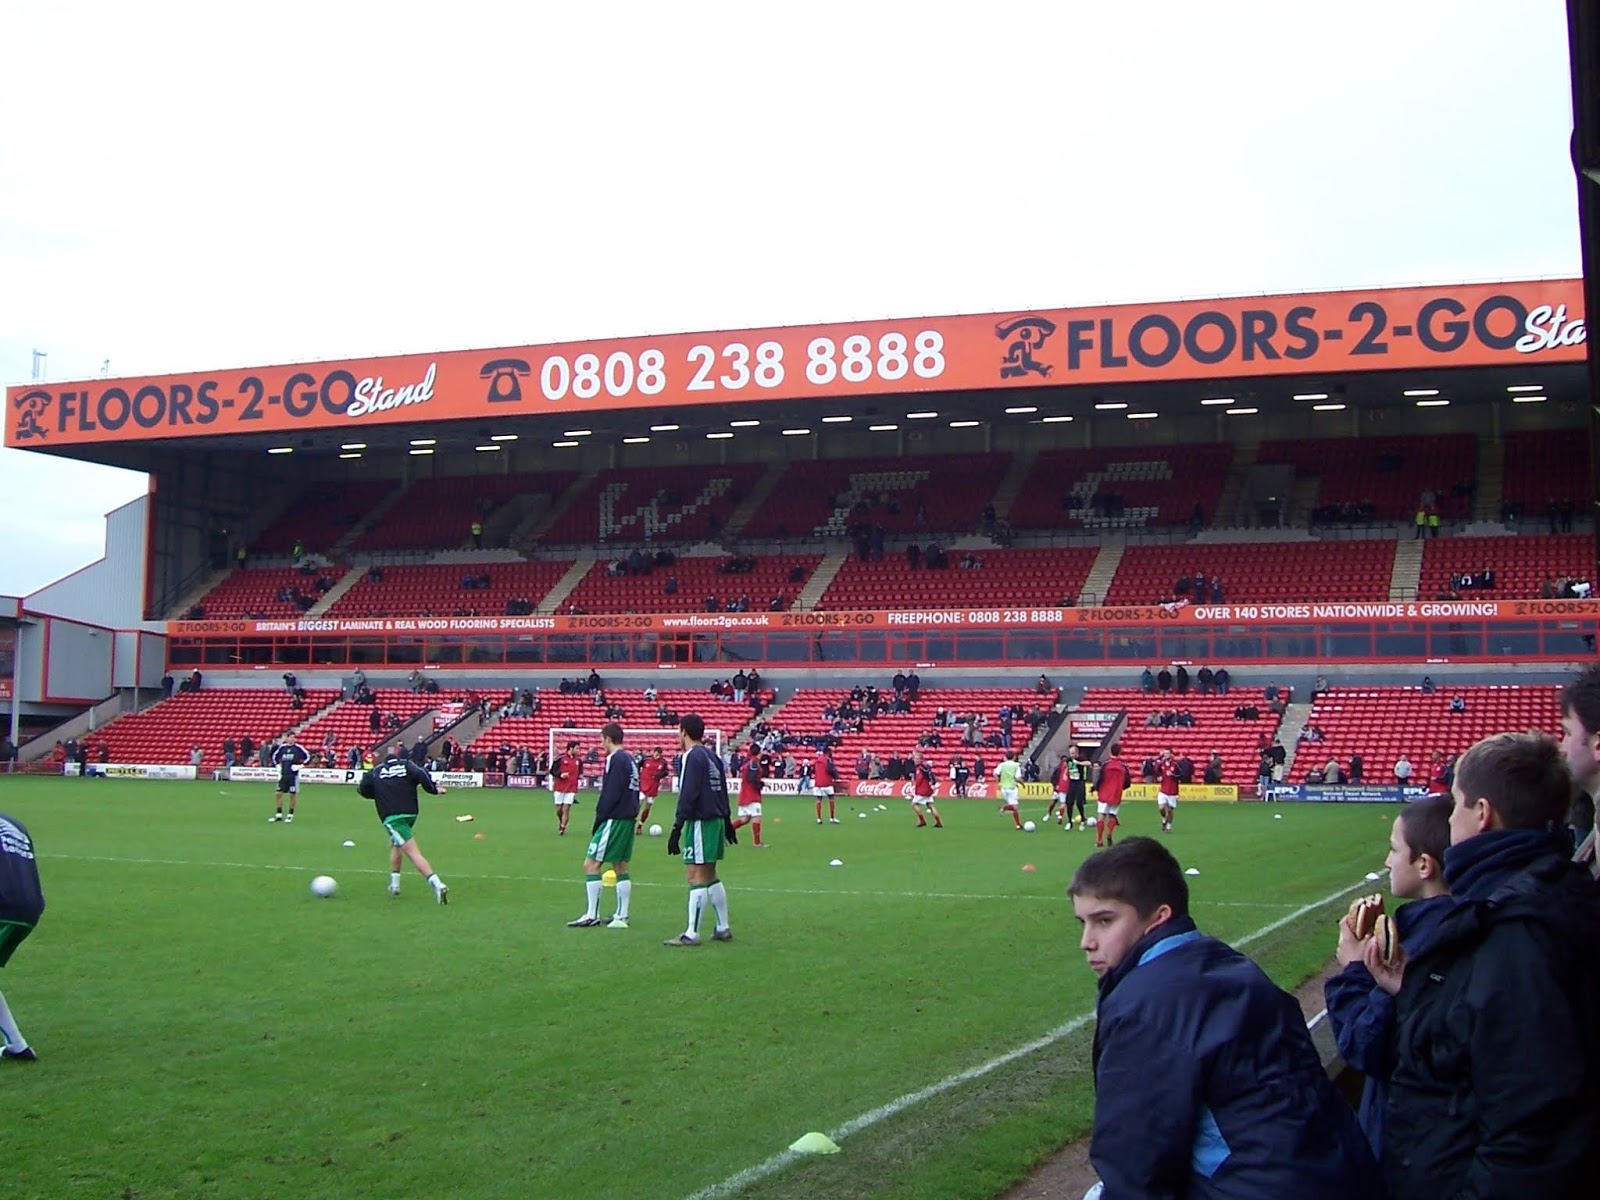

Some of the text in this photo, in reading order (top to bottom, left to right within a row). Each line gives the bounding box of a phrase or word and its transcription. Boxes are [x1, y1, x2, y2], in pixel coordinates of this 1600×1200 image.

[1067, 295, 1587, 370] FLOORS-2-GO Sta
[540, 330, 946, 400] 0808 238 8888
[58, 362, 437, 432] FLOORS-2-GO Stand
[886, 609, 1063, 624] FREEPHONE: 0808 238 8888
[1091, 608, 1179, 620] FLOORS-2-GO
[1195, 603, 1498, 619] OVER 140 STORES NATIONWIDE & GROWING!
[256, 618, 555, 631] BRITAIN'S BIGGEST LAMINATE & REAL WOOD FLOORING SPECIALISTS
[578, 616, 653, 627] FLOORS-2-GO
[663, 615, 769, 627] www.floors2go.co.uk
[794, 613, 875, 625] FLOORS-2-GO
[185, 622, 246, 632] FLOORS-2-GO
[442, 773, 474, 781] Painting
